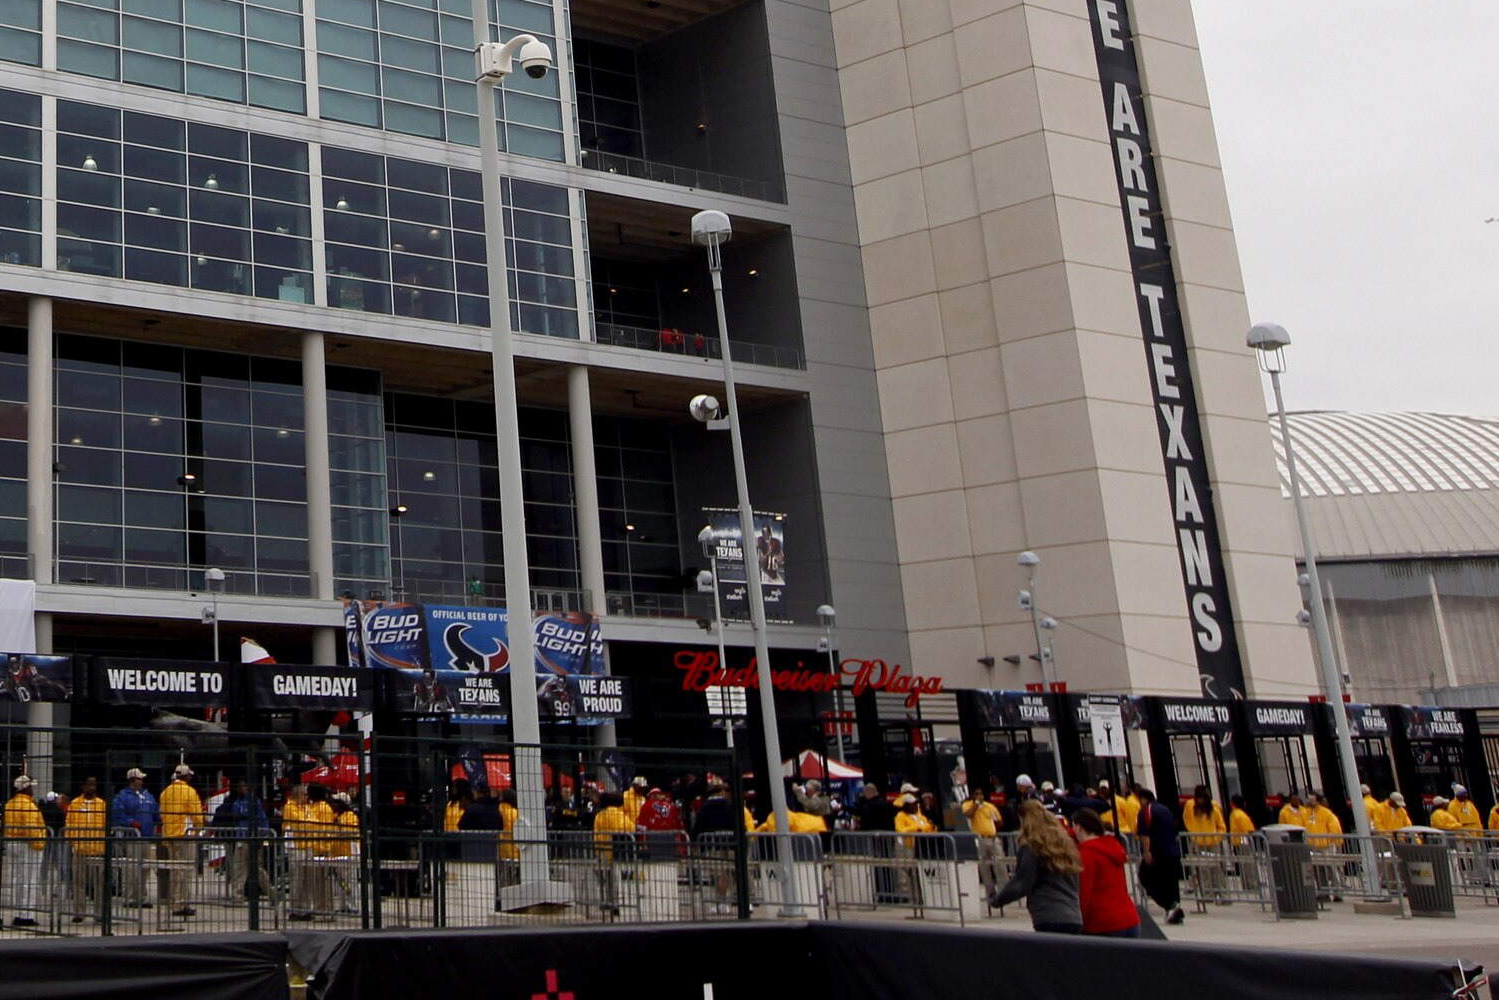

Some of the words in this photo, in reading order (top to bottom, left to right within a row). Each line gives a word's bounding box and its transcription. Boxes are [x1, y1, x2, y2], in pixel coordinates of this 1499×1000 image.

[1112, 82, 1157, 250] ARE
[1140, 283, 1223, 652] TEXANS
[715, 547, 743, 558] TEXANS
[373, 614, 419, 631] BUD
[432, 610, 466, 620] OFFICIAL
[467, 611, 487, 621] BEER
[488, 613, 498, 621] OF
[366, 627, 423, 645] LIGHT
[541, 622, 586, 642] BUD
[533, 633, 588, 656] LIGHT
[107, 668, 196, 692] WELCOME
[200, 672, 223, 693] TO
[273, 674, 357, 697] GAMEDAY!
[465, 677, 478, 687] WE
[478, 678, 493, 688] ARE
[579, 679, 599, 695] WE
[599, 679, 622, 695] ARE
[673, 650, 841, 692] Budeiser
[839, 658, 943, 709] Plaza
[458, 687, 500, 702] TEXANS
[583, 696, 622, 713] PROUD
[1019, 705, 1050, 718] TEXANS
[1164, 704, 1215, 723] WELCOME
[1215, 706, 1229, 722] TO
[1256, 707, 1305, 725] GAMEDAY!
[1361, 716, 1387, 728] TEXANS
[1431, 711, 1444, 721] WE
[1443, 711, 1458, 722] ARE
[1430, 721, 1464, 735] FEARLESS
